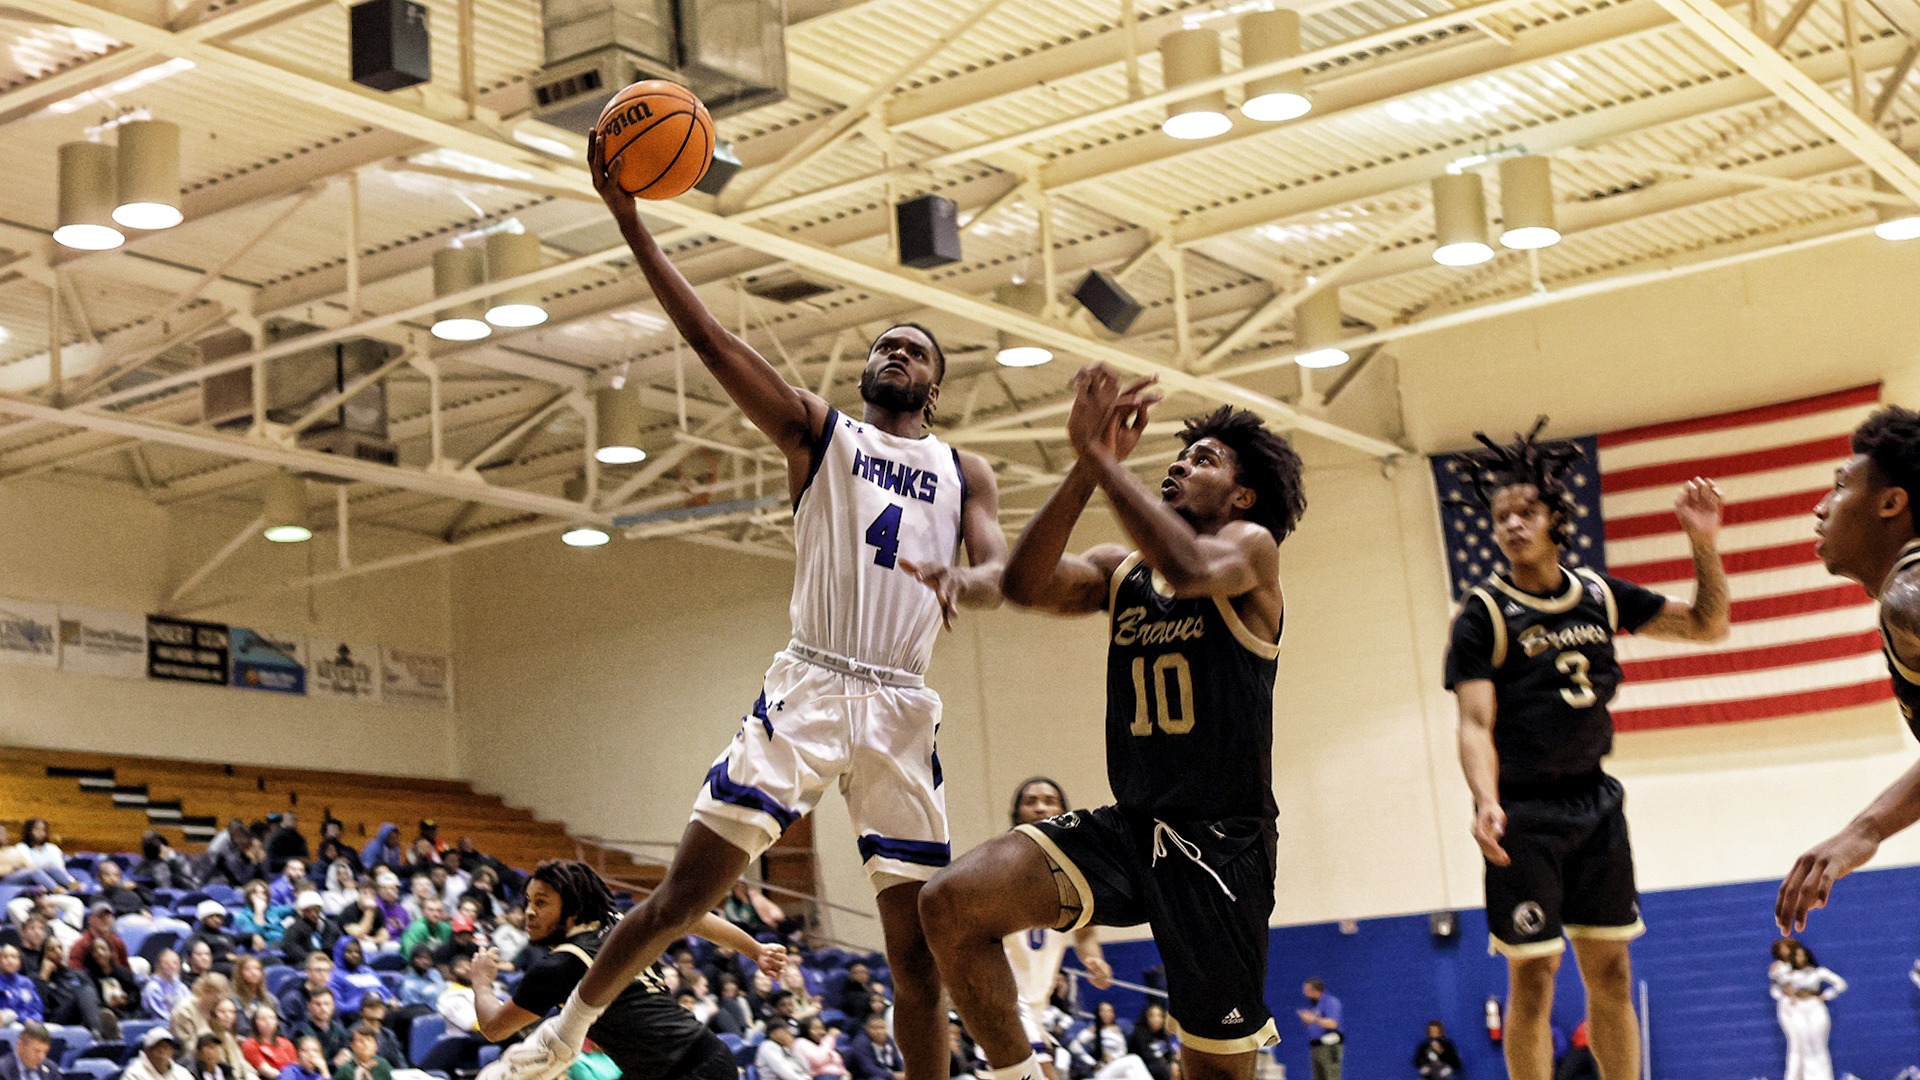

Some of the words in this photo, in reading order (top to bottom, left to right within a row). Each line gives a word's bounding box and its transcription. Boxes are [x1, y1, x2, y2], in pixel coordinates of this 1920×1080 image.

[601, 101, 653, 138] Wils
[852, 448, 938, 504] HAWKS
[865, 503, 903, 570] 4
[1114, 606, 1205, 646] Braves
[1130, 653, 1195, 736] 10
[1555, 651, 1598, 709] 3
